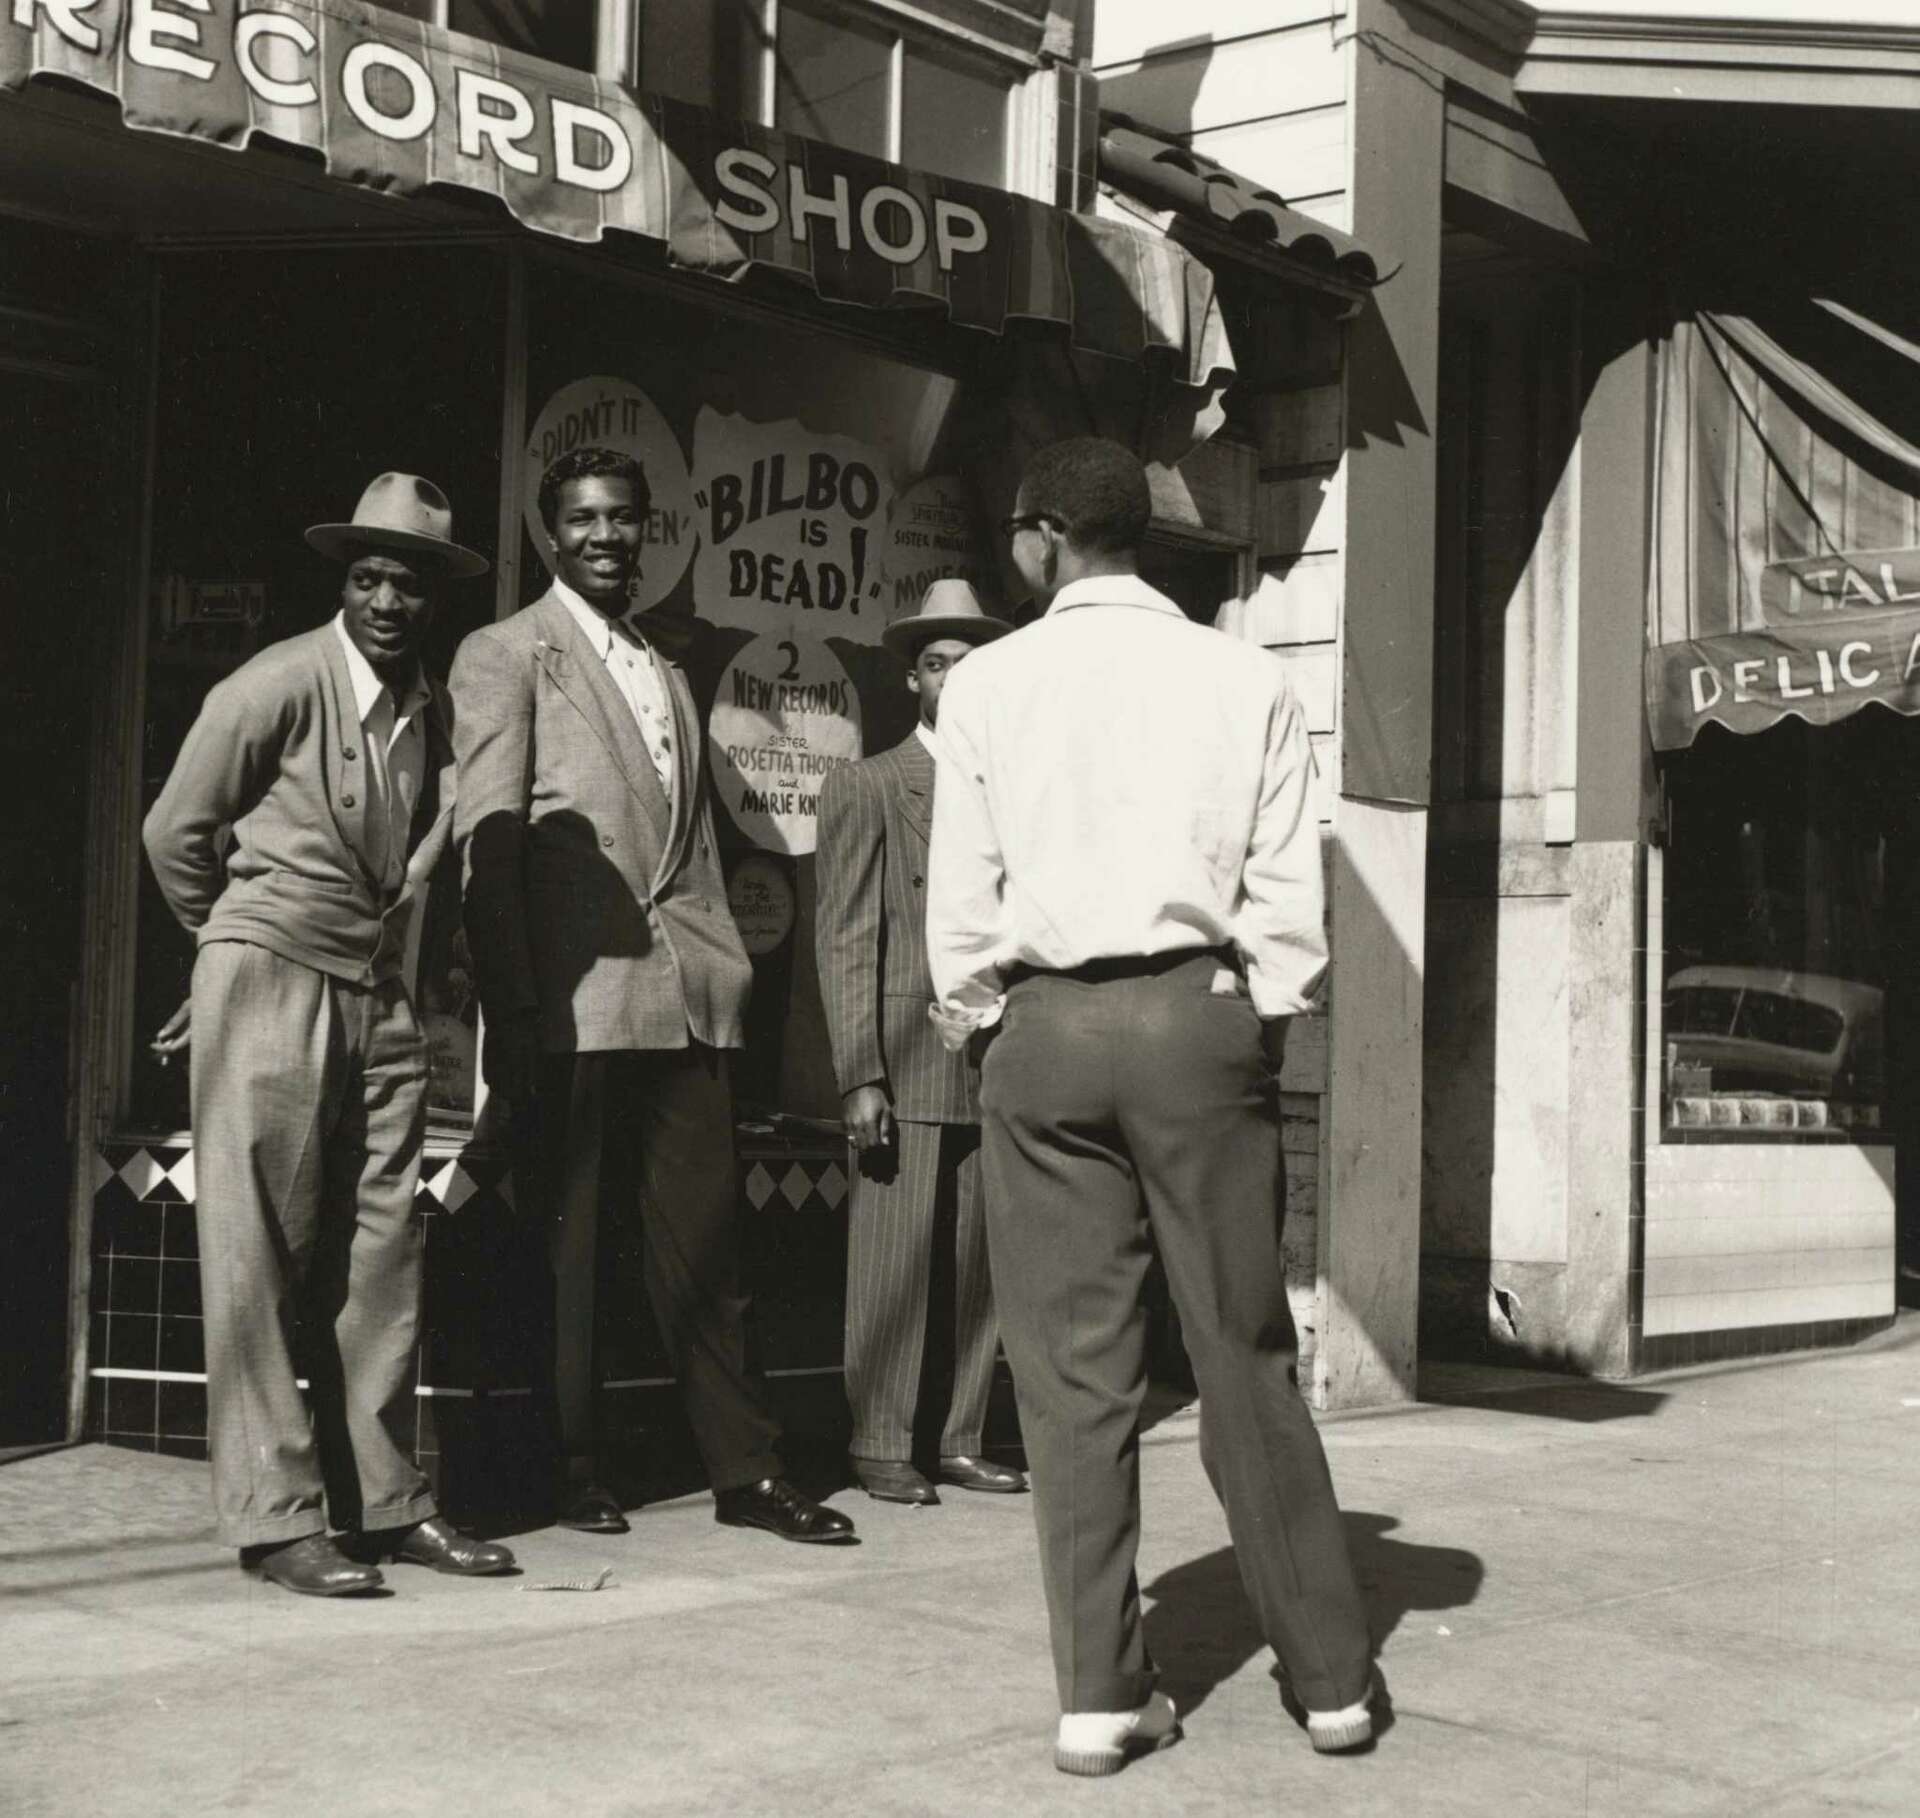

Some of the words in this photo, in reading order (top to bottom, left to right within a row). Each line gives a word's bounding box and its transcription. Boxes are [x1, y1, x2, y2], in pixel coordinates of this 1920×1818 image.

[714, 147, 988, 271] SHOP
[620, 397, 642, 436] IT
[801, 518, 828, 547] IS
[1789, 563, 1920, 613] ITAL
[777, 641, 800, 681] 2
[733, 668, 774, 711] NEW
[777, 679, 849, 718] RECORDS
[727, 745, 794, 774] ROSETTA
[767, 735, 809, 750] SISTER
[740, 790, 794, 816] MARIE
[798, 793, 821, 817] KN
